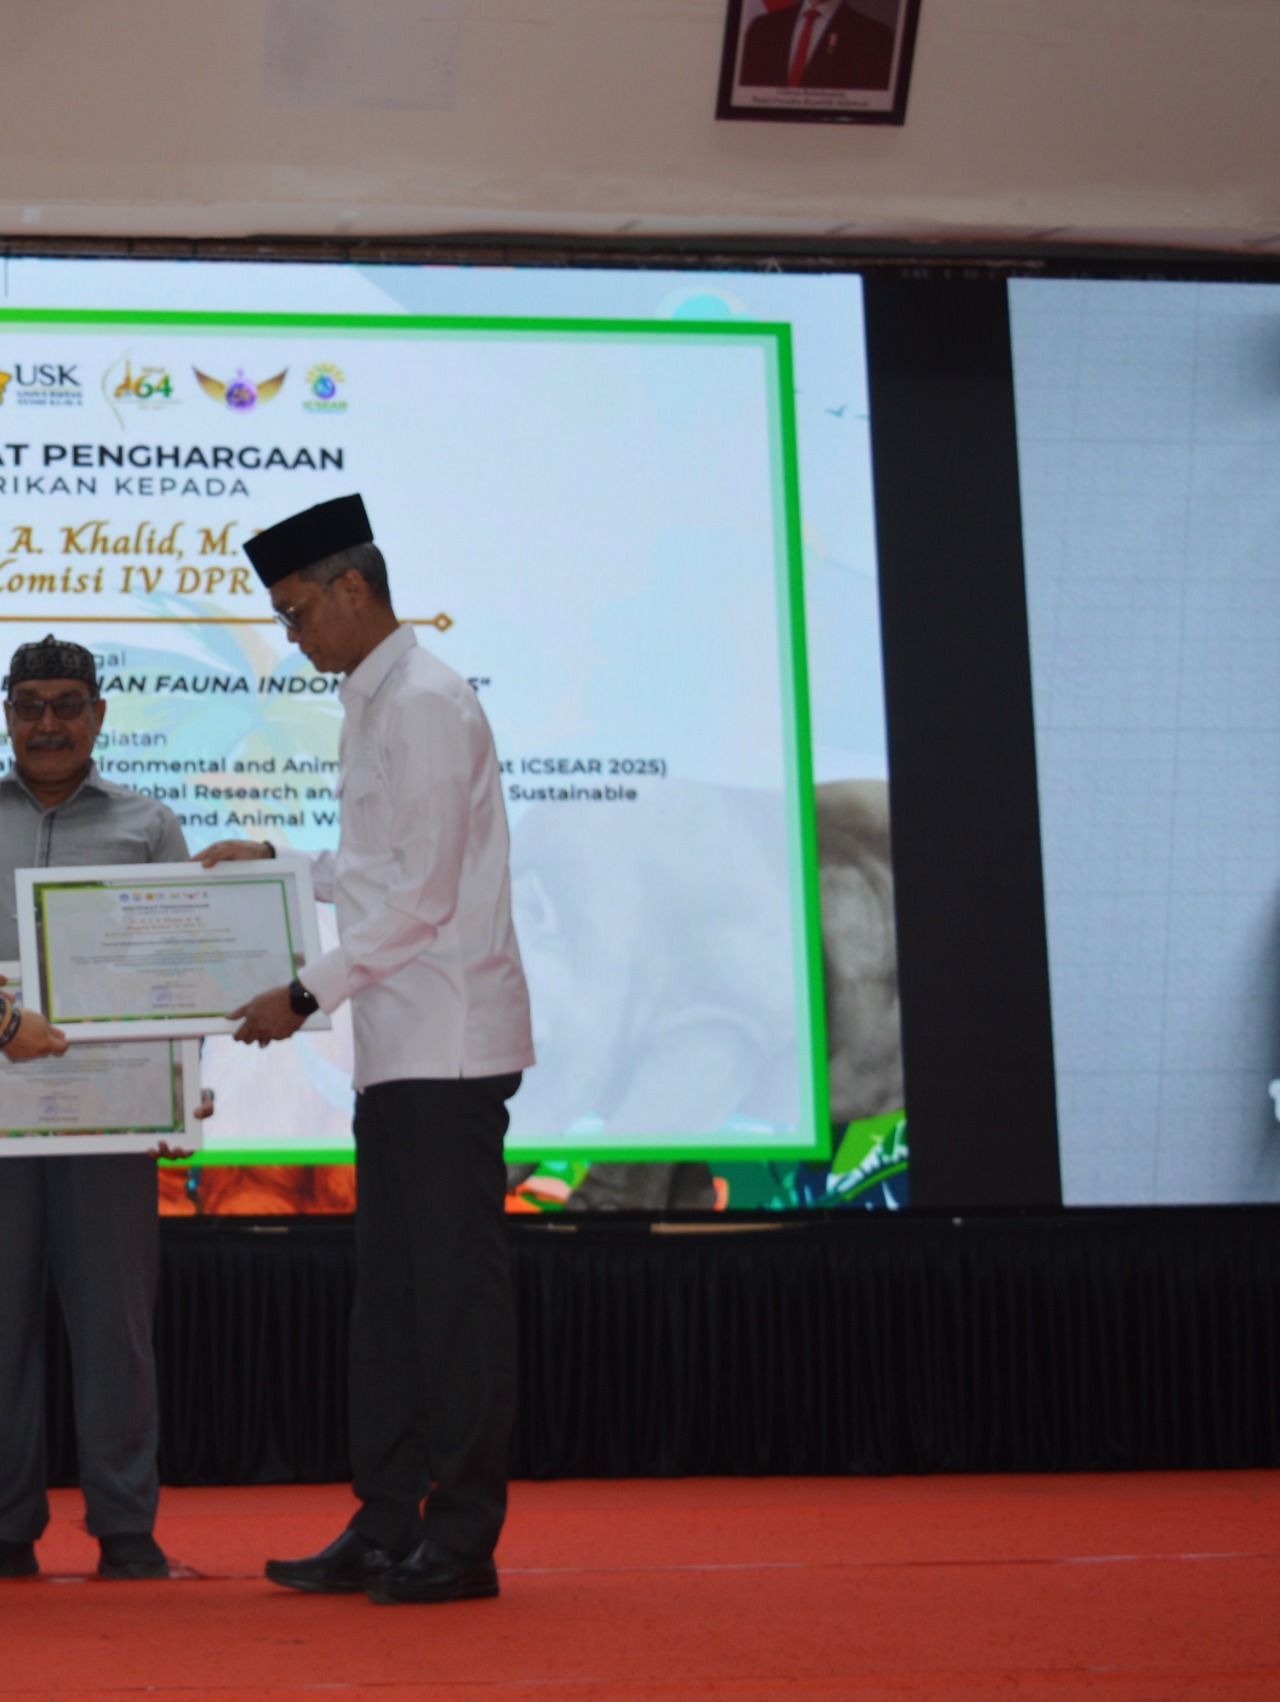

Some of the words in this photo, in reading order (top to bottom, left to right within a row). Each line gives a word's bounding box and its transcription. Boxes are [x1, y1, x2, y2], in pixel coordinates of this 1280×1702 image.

[15, 364, 81, 387] USK
[43, 444, 344, 470] PENGHARGAAN
[115, 476, 250, 497] KEPADA
[8, 526, 44, 554] A.
[60, 520, 186, 560] Khalid,
[198, 521, 238, 556] M.
[120, 565, 164, 594] IV
[176, 566, 253, 595] DPR
[155, 675, 250, 693] FAUNA
[94, 729, 168, 750] giatan
[99, 755, 226, 773] ironmental
[233, 757, 276, 774] and
[282, 756, 339, 773] Anim
[521, 758, 602, 775] ICSEAR
[609, 757, 668, 779] 2025)
[194, 782, 298, 800] Research
[509, 783, 638, 801] Sustainable
[224, 811, 304, 827] Animal
